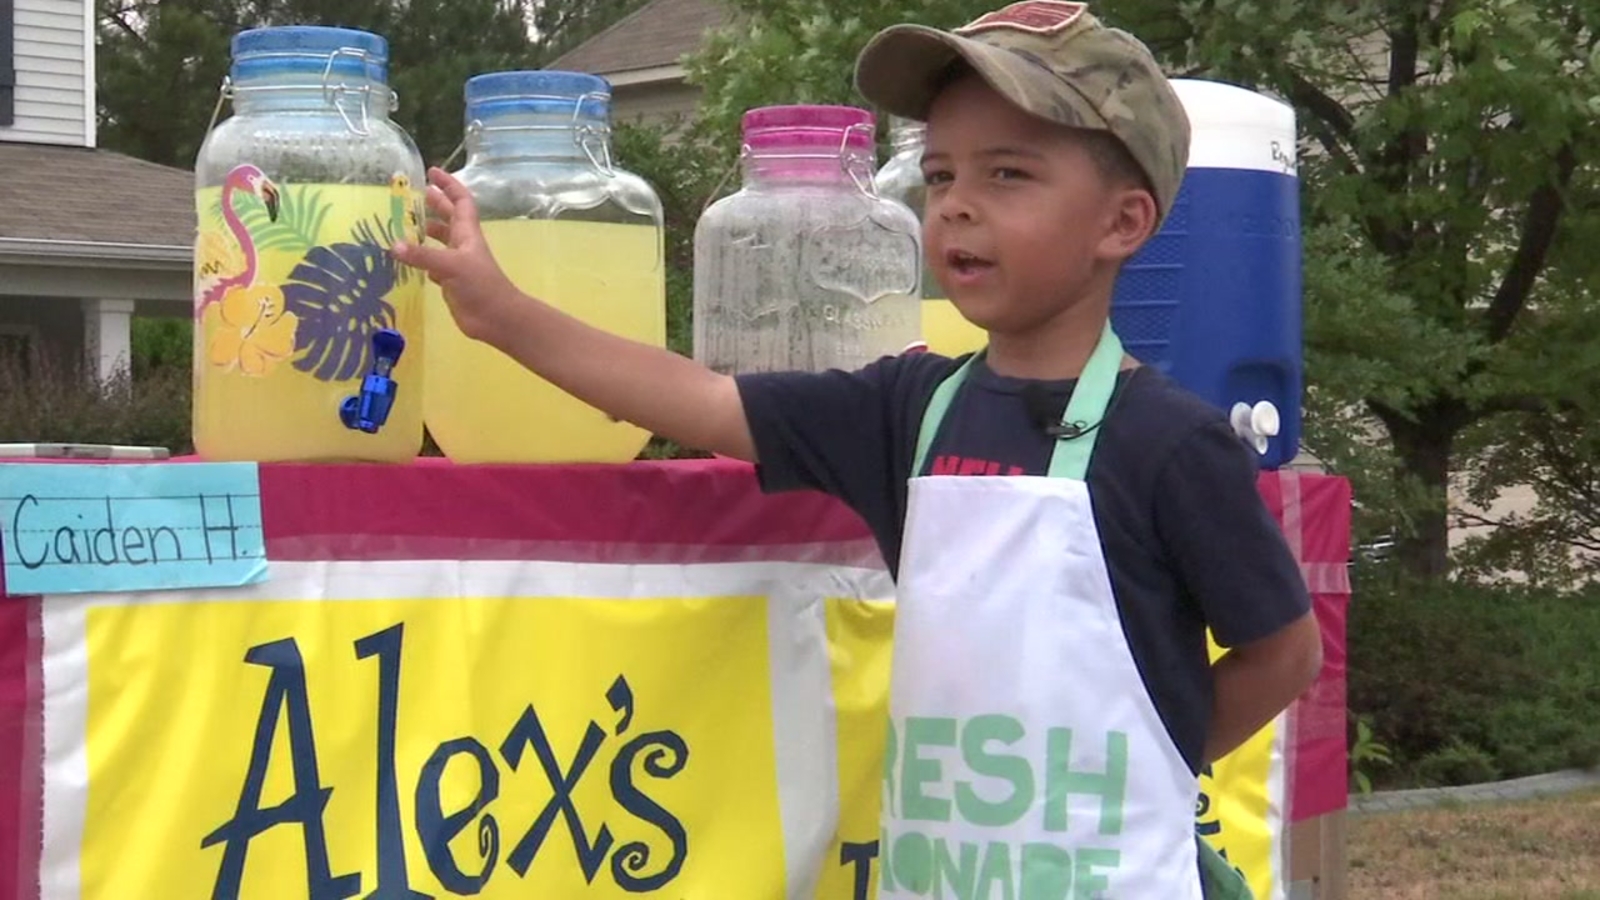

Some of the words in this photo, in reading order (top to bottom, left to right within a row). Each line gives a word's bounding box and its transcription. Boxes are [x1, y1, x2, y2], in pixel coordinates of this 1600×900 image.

[13, 494, 182, 569] Caiden
[199, 493, 248, 565] H.
[200, 622, 689, 900] Alex's
[881, 826, 1121, 900] ONADE
